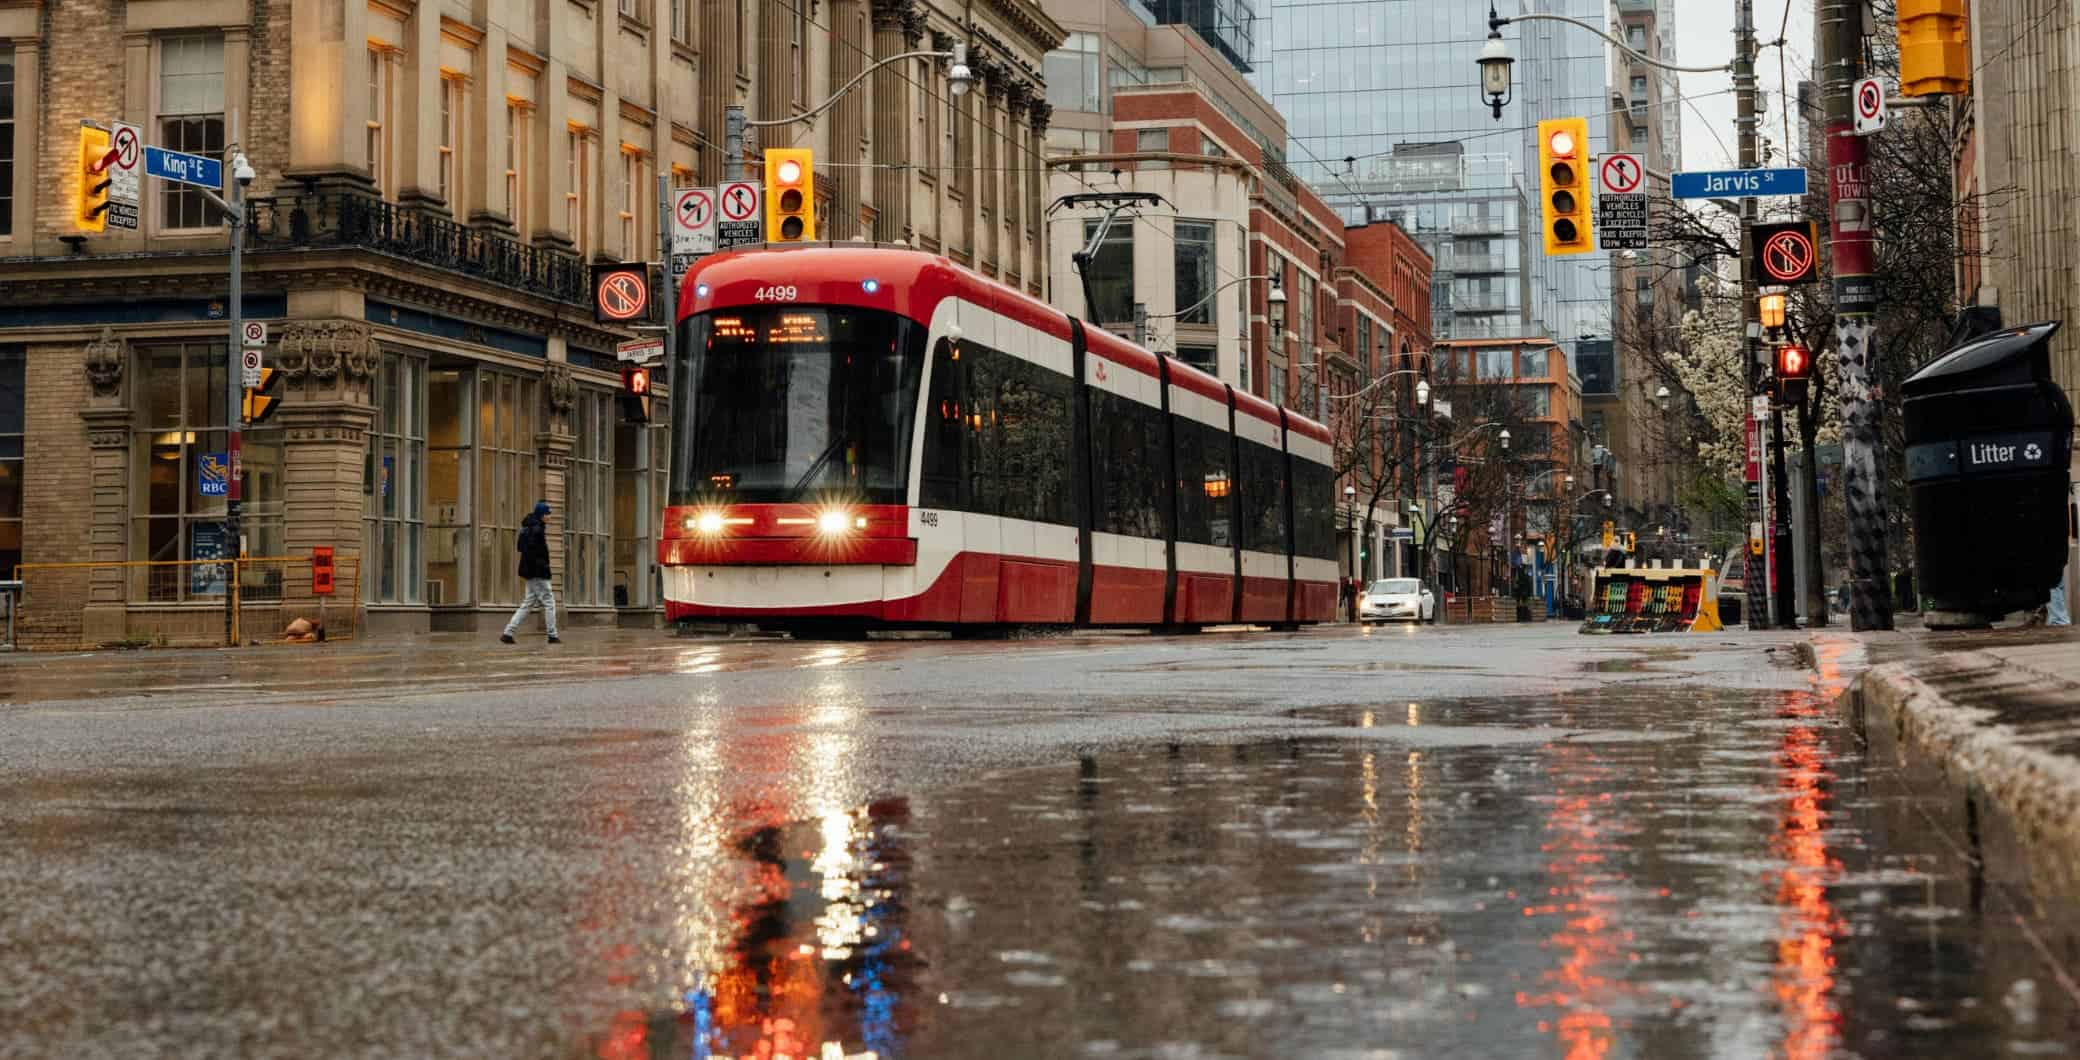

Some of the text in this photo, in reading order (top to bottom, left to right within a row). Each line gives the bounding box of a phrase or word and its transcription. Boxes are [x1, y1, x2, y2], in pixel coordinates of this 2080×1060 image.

[163, 152, 187, 179] King
[197, 159, 203, 178] E
[1703, 171, 1774, 192] Jarvis St
[1606, 202, 1640, 210] VEHICLES
[1600, 210, 1645, 218] AND BICYCLES
[724, 229, 754, 237] VEHICLES
[719, 237, 758, 246] AND BICYCLES
[755, 285, 797, 301] 4499
[1970, 443, 2017, 465] Litter
[202, 482, 228, 493] RBC
[920, 511, 938, 527] 4499
